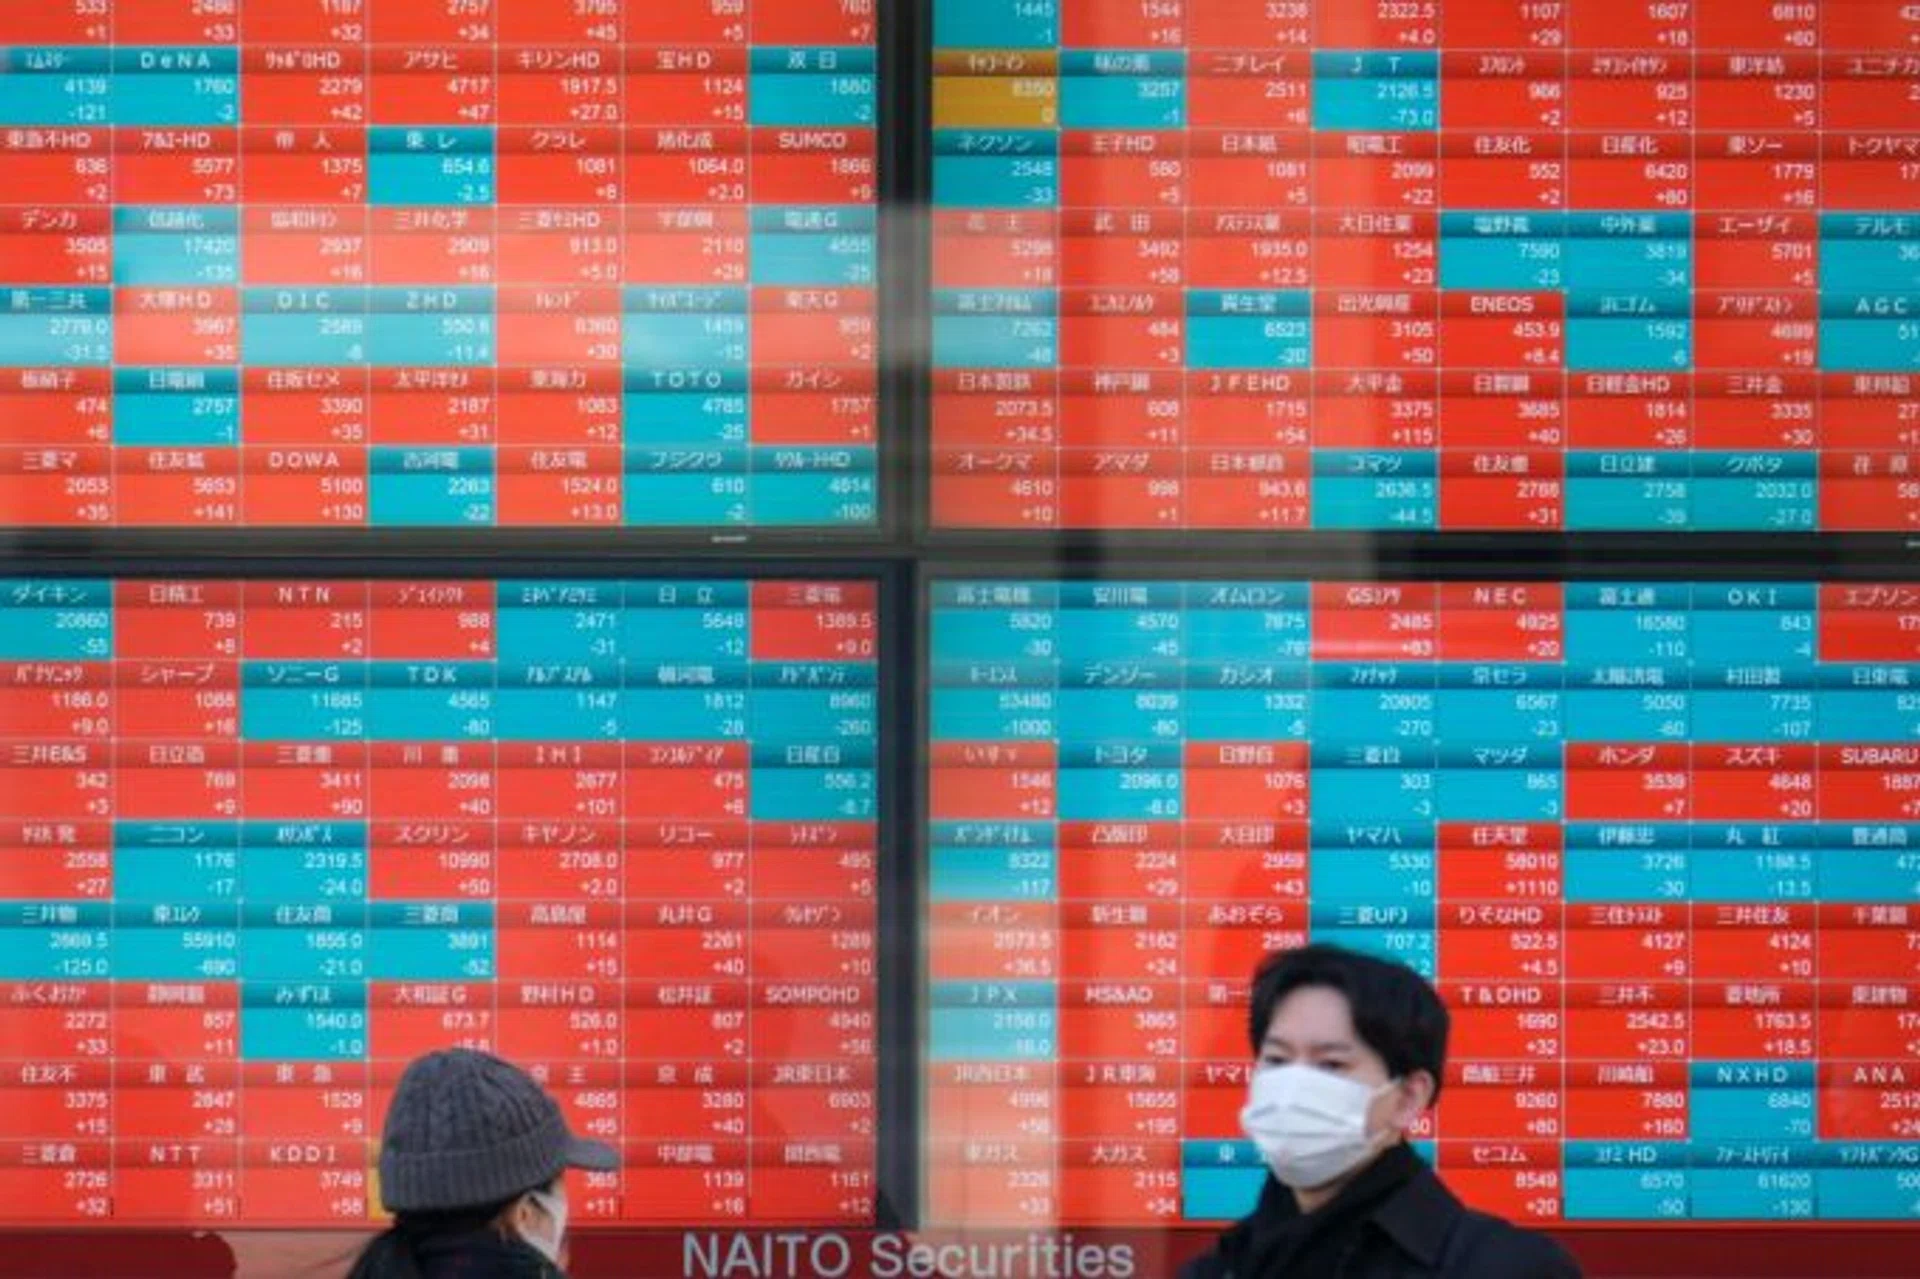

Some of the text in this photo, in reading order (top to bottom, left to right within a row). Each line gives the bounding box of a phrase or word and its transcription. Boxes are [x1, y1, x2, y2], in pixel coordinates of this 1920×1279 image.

[1378, 2, 1434, 19] 2322.5
[1520, 0, 1561, 19] 1107
[330, 23, 362, 42] +32
[457, 23, 489, 42] +34
[1399, 26, 1434, 45] +4.0
[404, 50, 458, 70] アサヒ
[519, 50, 601, 70] キリンHD
[319, 77, 362, 95] 2279
[446, 77, 489, 95] 4717
[560, 77, 616, 95] 1917.5
[703, 77, 744, 95] 1124
[1264, 80, 1307, 99] 2511
[330, 102, 362, 121] +42
[457, 102, 489, 121] +47
[569, 102, 616, 121] +27.0
[712, 102, 744, 121] +15
[1655, 107, 1687, 126] +12
[778, 130, 847, 149] SUMCO
[957, 134, 1033, 154] ネクソン
[192, 157, 235, 175] 5577
[321, 157, 362, 175] 1375
[689, 157, 744, 175] 1064.0
[1773, 161, 1814, 180] 1779
[203, 182, 235, 202] +73
[339, 182, 362, 202] +7
[707, 182, 744, 202] +2.0
[1402, 186, 1434, 205] +22
[22, 209, 78, 230] デンカ
[1393, 238, 1434, 259] 1254
[1771, 239, 1814, 260] 5701
[1259, 265, 1307, 285] +12.5
[1402, 265, 1434, 285] +23
[1470, 294, 1535, 314] ENEOS
[1392, 319, 1434, 340] 3105
[1512, 319, 1561, 340] 453.9
[75, 396, 106, 414] 474
[320, 396, 362, 414] 3390
[1266, 399, 1307, 419] 1715
[1392, 399, 1434, 419] 3375
[331, 422, 362, 441] +35
[458, 422, 489, 441] +31
[586, 422, 616, 441] +12
[1392, 425, 1434, 445] +115
[1528, 425, 1561, 445] +40
[320, 476, 362, 495] 5100
[193, 502, 235, 521] +141
[321, 502, 362, 521] +130
[1259, 506, 1307, 525] +11.7
[1526, 506, 1561, 525] +31
[12, 585, 86, 604] ダイキン
[330, 611, 362, 629] 215
[575, 611, 616, 629] 2471
[141, 665, 215, 683] シャープ
[267, 665, 340, 683] ソニーG
[1219, 666, 1275, 686] カシオ
[577, 692, 616, 709] 1147
[703, 692, 744, 709] 1812
[325, 718, 362, 736] -125
[1095, 747, 1147, 764] トヨタ
[1473, 745, 1529, 765] マツダ
[1599, 745, 1656, 765] ホンダ
[1725, 745, 1781, 765] スズキ
[320, 770, 362, 790] 3411
[331, 797, 362, 816] +90
[575, 797, 616, 816] +101
[148, 825, 205, 844] ニコン
[522, 825, 596, 844] キヤノン
[659, 825, 714, 844] リコー
[1346, 825, 1402, 846] ヤマハ
[194, 850, 235, 869] 1176
[304, 850, 362, 869] 2319.5
[75, 877, 106, 896] +27
[1505, 878, 1561, 897] +1110
[577, 931, 616, 950] 1114
[1642, 931, 1687, 951] 4127
[1769, 931, 1814, 951] 4124
[713, 957, 744, 976] +40
[11, 985, 87, 1004] ふくおか
[765, 985, 860, 1004] SOMPOHD
[1471, 1144, 1528, 1164] セコム
[683, 1232, 1135, 1278] NAITO Securities
